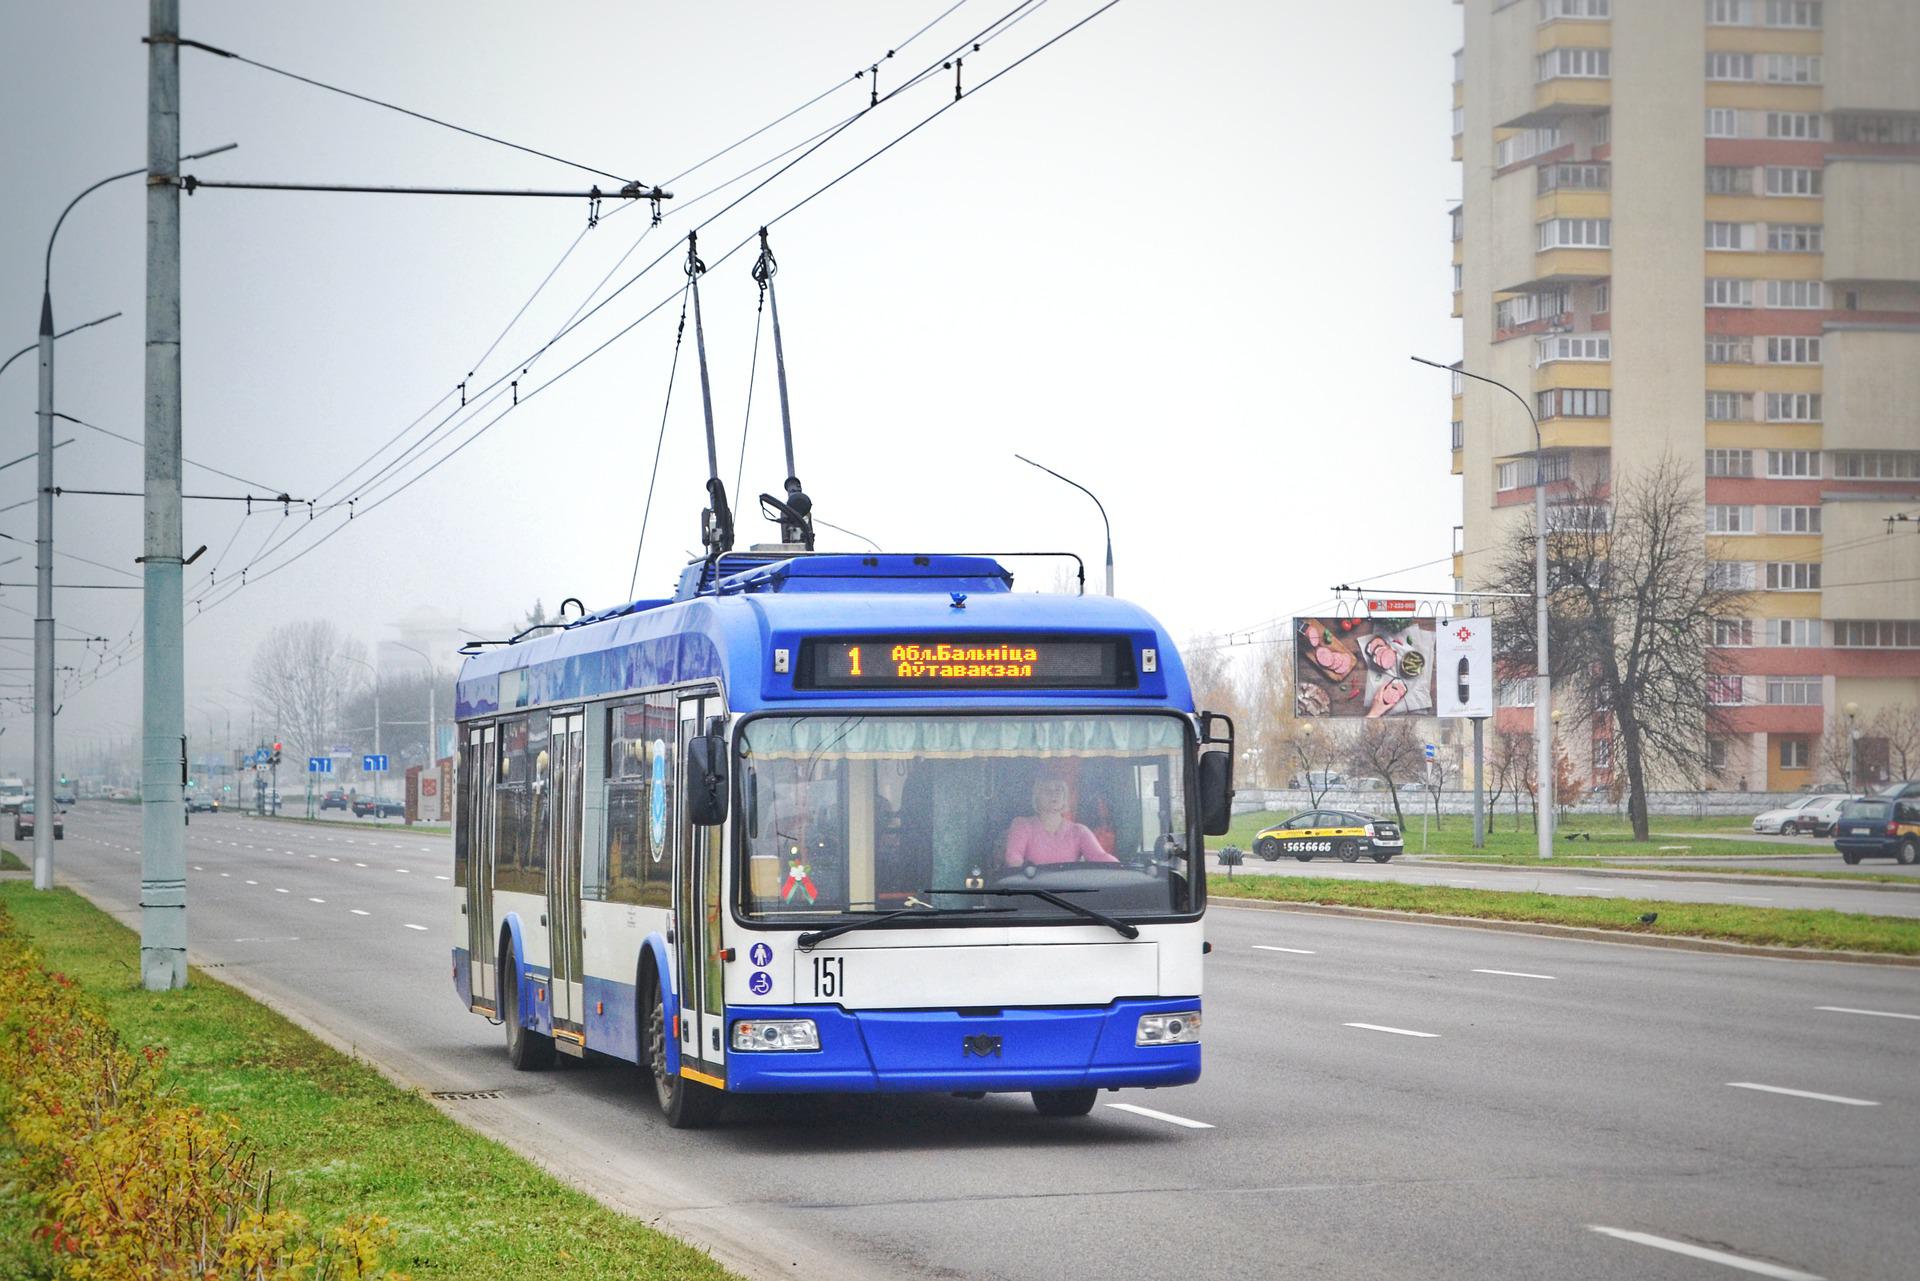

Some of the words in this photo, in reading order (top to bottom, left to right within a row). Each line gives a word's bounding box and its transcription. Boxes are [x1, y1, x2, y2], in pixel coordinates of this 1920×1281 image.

[849, 647, 861, 675] 1
[892, 645, 1037, 662] Абл.Бальніца
[898, 661, 1032, 677] Аўтавакзал
[813, 957, 843, 997] 151
